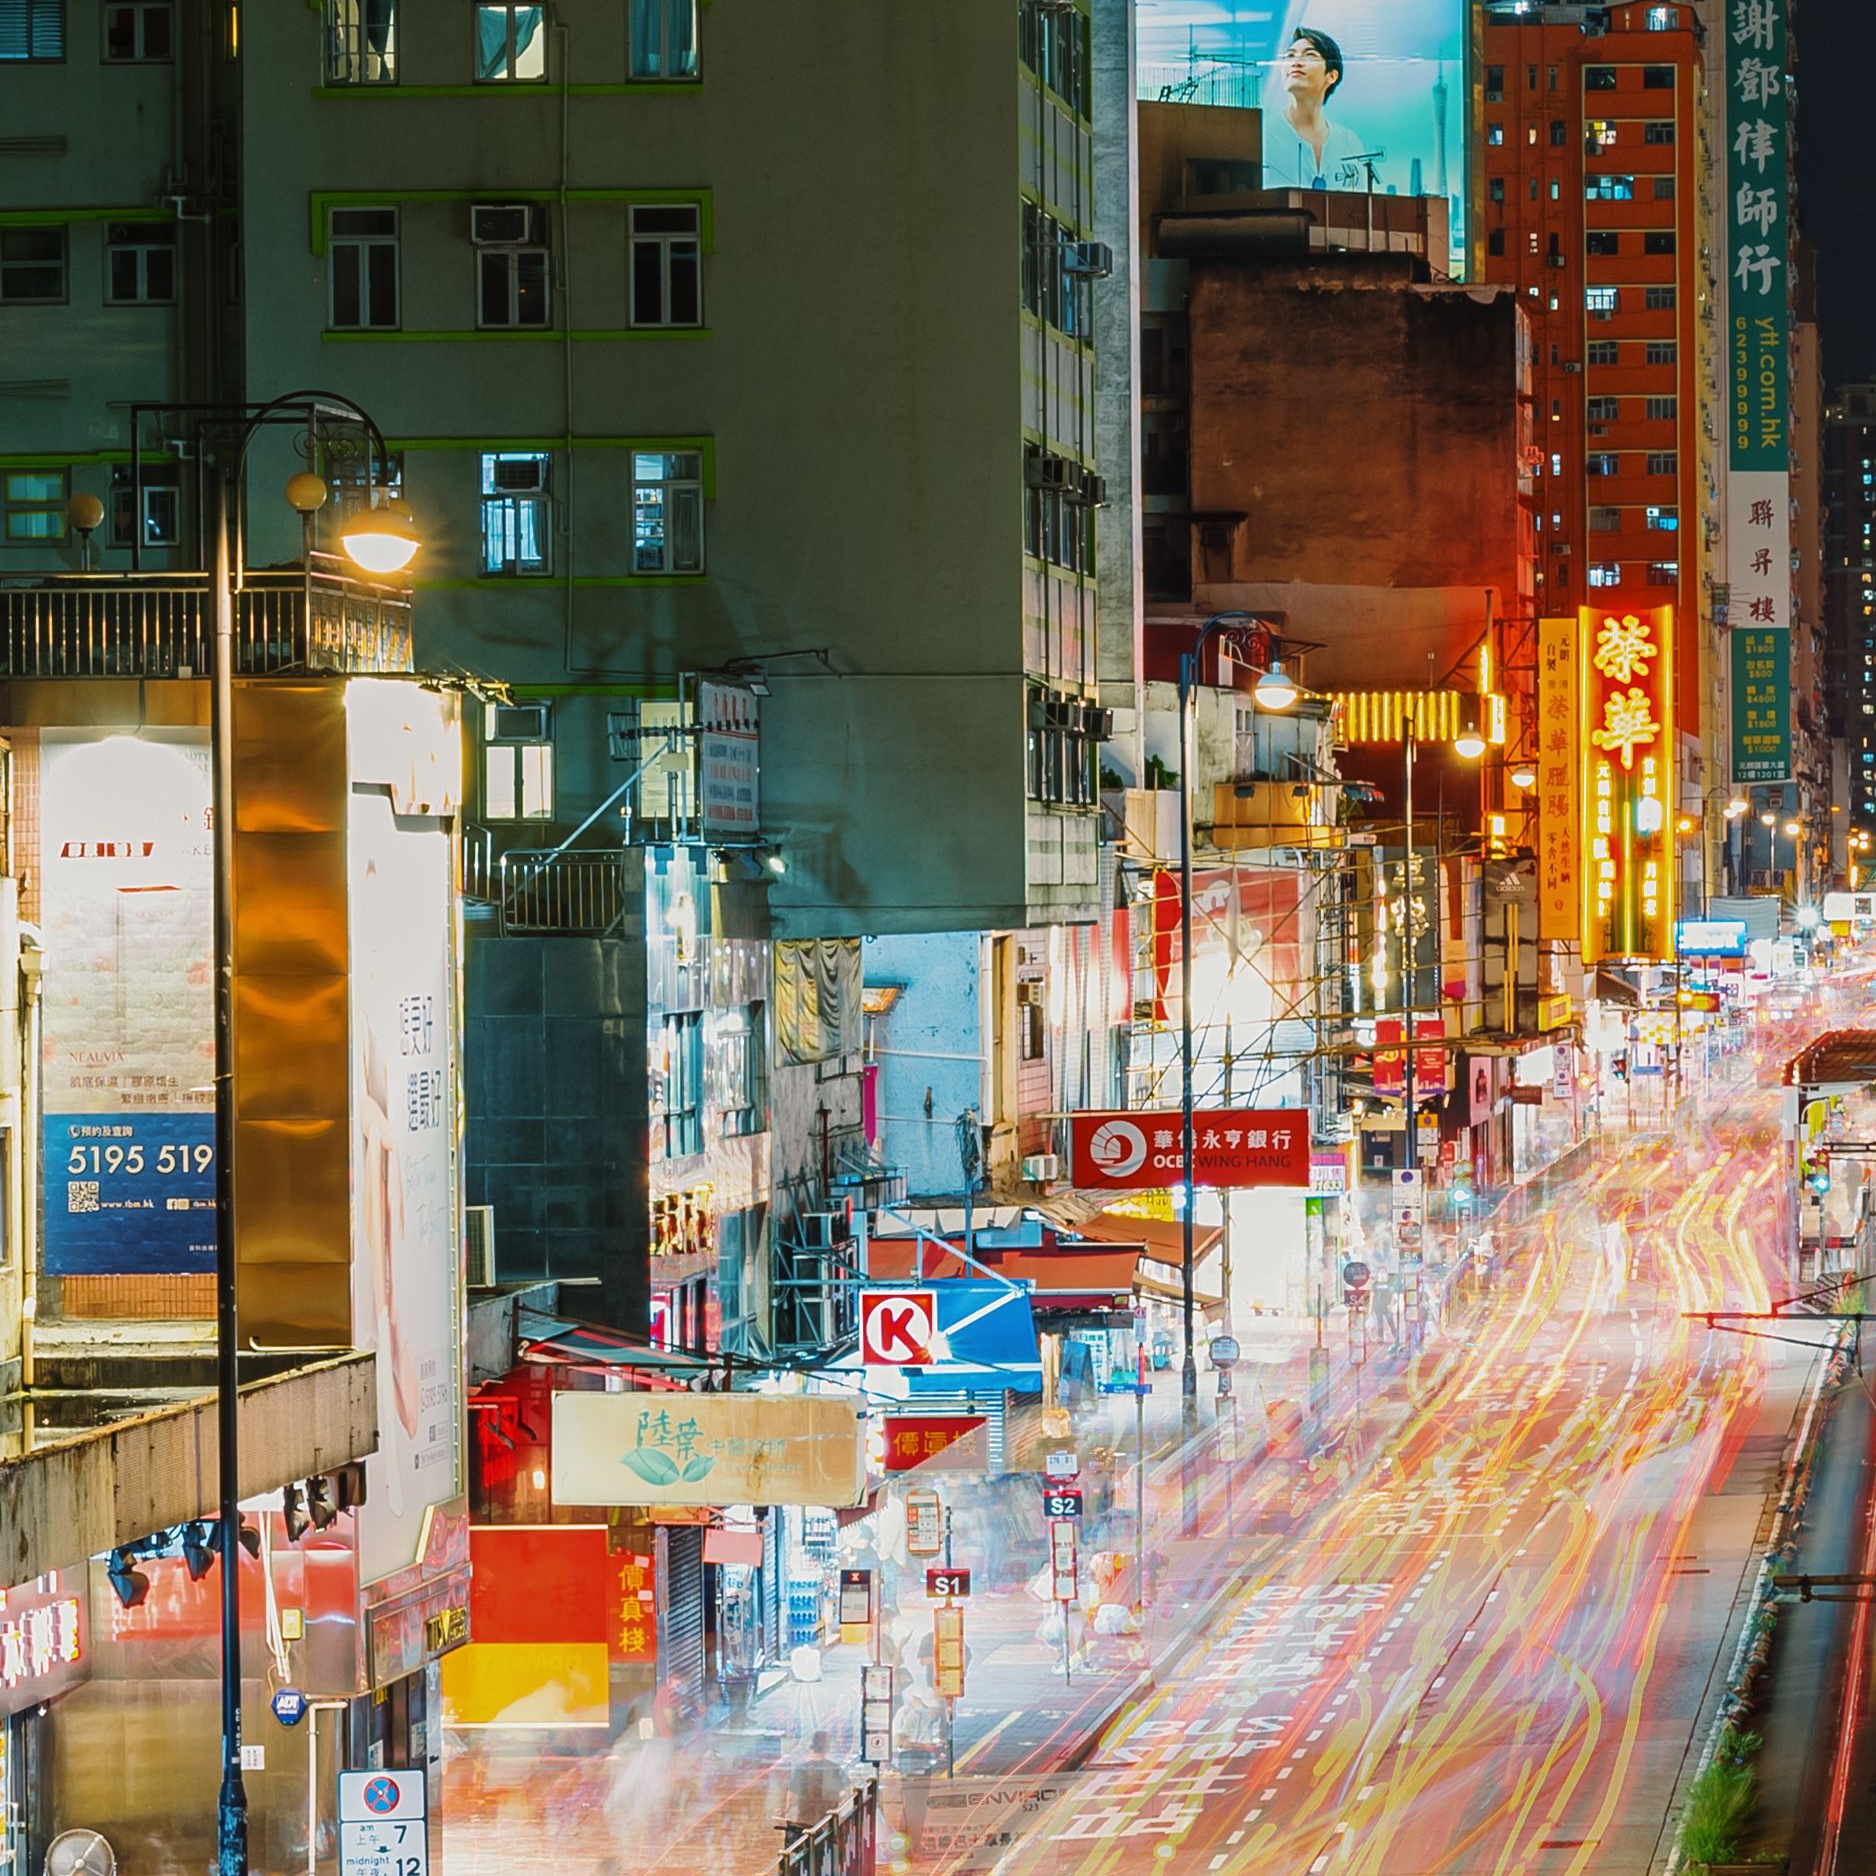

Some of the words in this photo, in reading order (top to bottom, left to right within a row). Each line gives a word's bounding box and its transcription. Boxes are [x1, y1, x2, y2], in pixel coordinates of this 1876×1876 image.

[1748, 499, 1775, 623] 聯昇樓
[1592, 615, 1661, 770] 榮華
[67, 1145, 144, 1174] 5195
[1153, 1154, 1196, 1169] OCB
[1199, 1154, 1241, 1168] WING
[1245, 1154, 1292, 1168] HANG
[880, 1308, 914, 1352] K
[637, 1409, 704, 1459] 陸葉
[1051, 1498, 1075, 1515] S2
[935, 1577, 961, 1595] S1
[1252, 1583, 1394, 1600] BUS
[1232, 1602, 1386, 1621] STOP
[1212, 1623, 1358, 1650] 巴士
[277, 1695, 299, 1709] ADT
[1129, 1715, 1294, 1739] BUS
[1098, 1739, 1283, 1765] STOP
[1071, 1764, 1247, 1802] 巴士
[1047, 1802, 1204, 1841] 站
[356, 1836, 380, 1846] 上午
[394, 1825, 407, 1844] 7
[347, 1855, 390, 1866] midnight
[396, 1857, 421, 1876] 12
